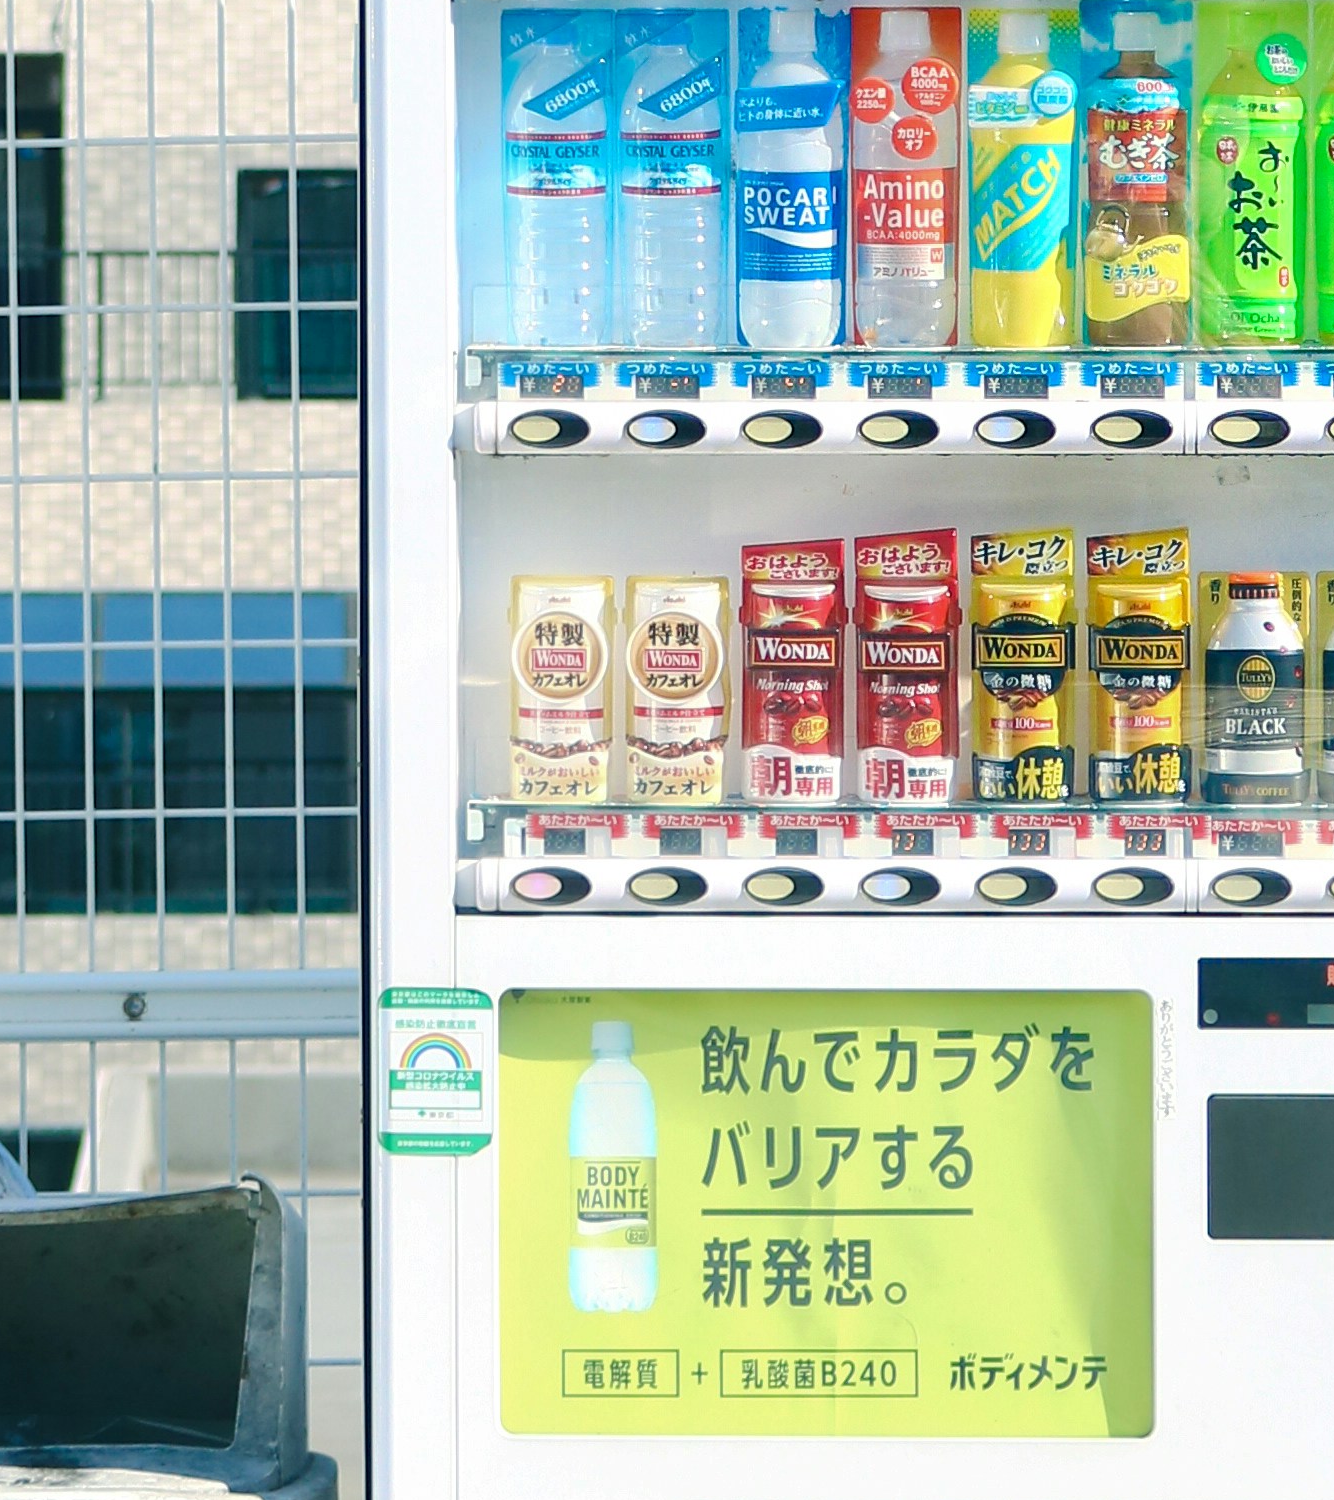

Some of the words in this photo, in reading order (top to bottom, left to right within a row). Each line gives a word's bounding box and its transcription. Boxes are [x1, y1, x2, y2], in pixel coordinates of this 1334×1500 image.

[911, 67, 949, 78] BCAA
[897, 127, 931, 139] カロリー
[1103, 119, 1176, 132] 健康ミネラル
[510, 145, 551, 158] CRYSTAL
[555, 145, 599, 158] GEYSER
[625, 144, 667, 158] CRYSTAL
[670, 144, 714, 158] GEYSER
[905, 139, 923, 151] オフ
[1098, 132, 1180, 170] むぎ茶
[744, 186, 837, 205] POCARI
[864, 173, 945, 200] Amino
[973, 148, 1062, 251] MATCH
[744, 205, 830, 226] SWEAT
[863, 203, 945, 229] -Value
[1228, 171, 1282, 270] お茶
[867, 230, 940, 241] BCAA:4000mg
[1102, 265, 1158, 281] ミネラル
[857, 543, 939, 567] おはよう
[973, 536, 1066, 567] キレ・コク
[1092, 540, 1183, 567] キレ・コク
[745, 553, 828, 571] おはよう
[881, 561, 951, 576] ございます!
[770, 567, 838, 580] ございます!
[1210, 579, 1222, 605] 香り
[1291, 578, 1302, 621] 圧倒的な
[535, 622, 584, 646] 特製
[648, 621, 699, 646] 特製
[756, 636, 830, 660] WONDA
[866, 641, 940, 665] WONDA
[982, 637, 1056, 659] WONDA
[1102, 638, 1178, 660] WONDA
[535, 651, 582, 667] WONDA
[650, 651, 697, 667] WONDA
[532, 673, 589, 688] カフェオレ
[646, 673, 703, 688] カフェオレ
[756, 678, 804, 692] Morning
[869, 681, 915, 697] Morning
[1225, 717, 1287, 735] BLACK
[519, 780, 599, 796] カフェオレ
[634, 780, 714, 796] カフェオレ
[794, 777, 834, 797] 専用
[907, 780, 947, 799] 専用
[701, 1025, 1097, 1094] 飲んでカラダを
[702, 1125, 974, 1191] バリアする
[587, 1166, 640, 1186] BODY
[577, 1183, 649, 1208] MAINTÉ
[702, 1238, 909, 1308] 新発想。
[582, 1359, 659, 1389] 電解質
[741, 1359, 898, 1389] 乳酸菌B240
[950, 1355, 1108, 1392] ボディメンテ
